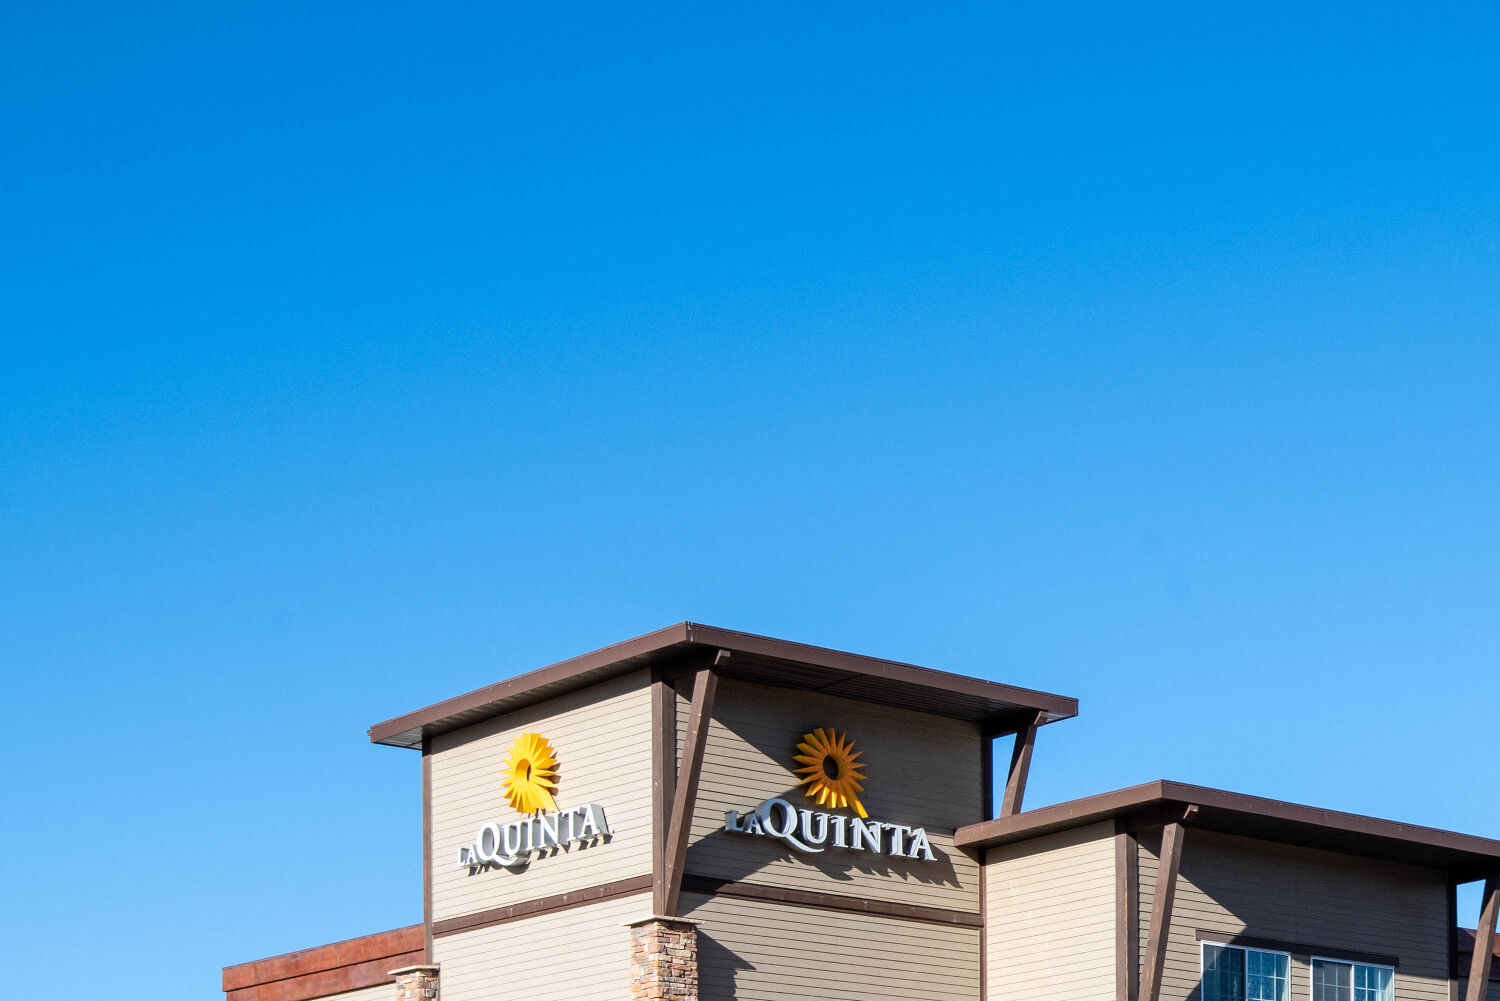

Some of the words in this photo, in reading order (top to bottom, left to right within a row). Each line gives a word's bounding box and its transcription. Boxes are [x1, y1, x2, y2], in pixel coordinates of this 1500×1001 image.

[457, 843, 479, 867] LA
[476, 803, 604, 867] QUINTA
[725, 809, 765, 836] LA
[755, 798, 938, 862] QUINTA
